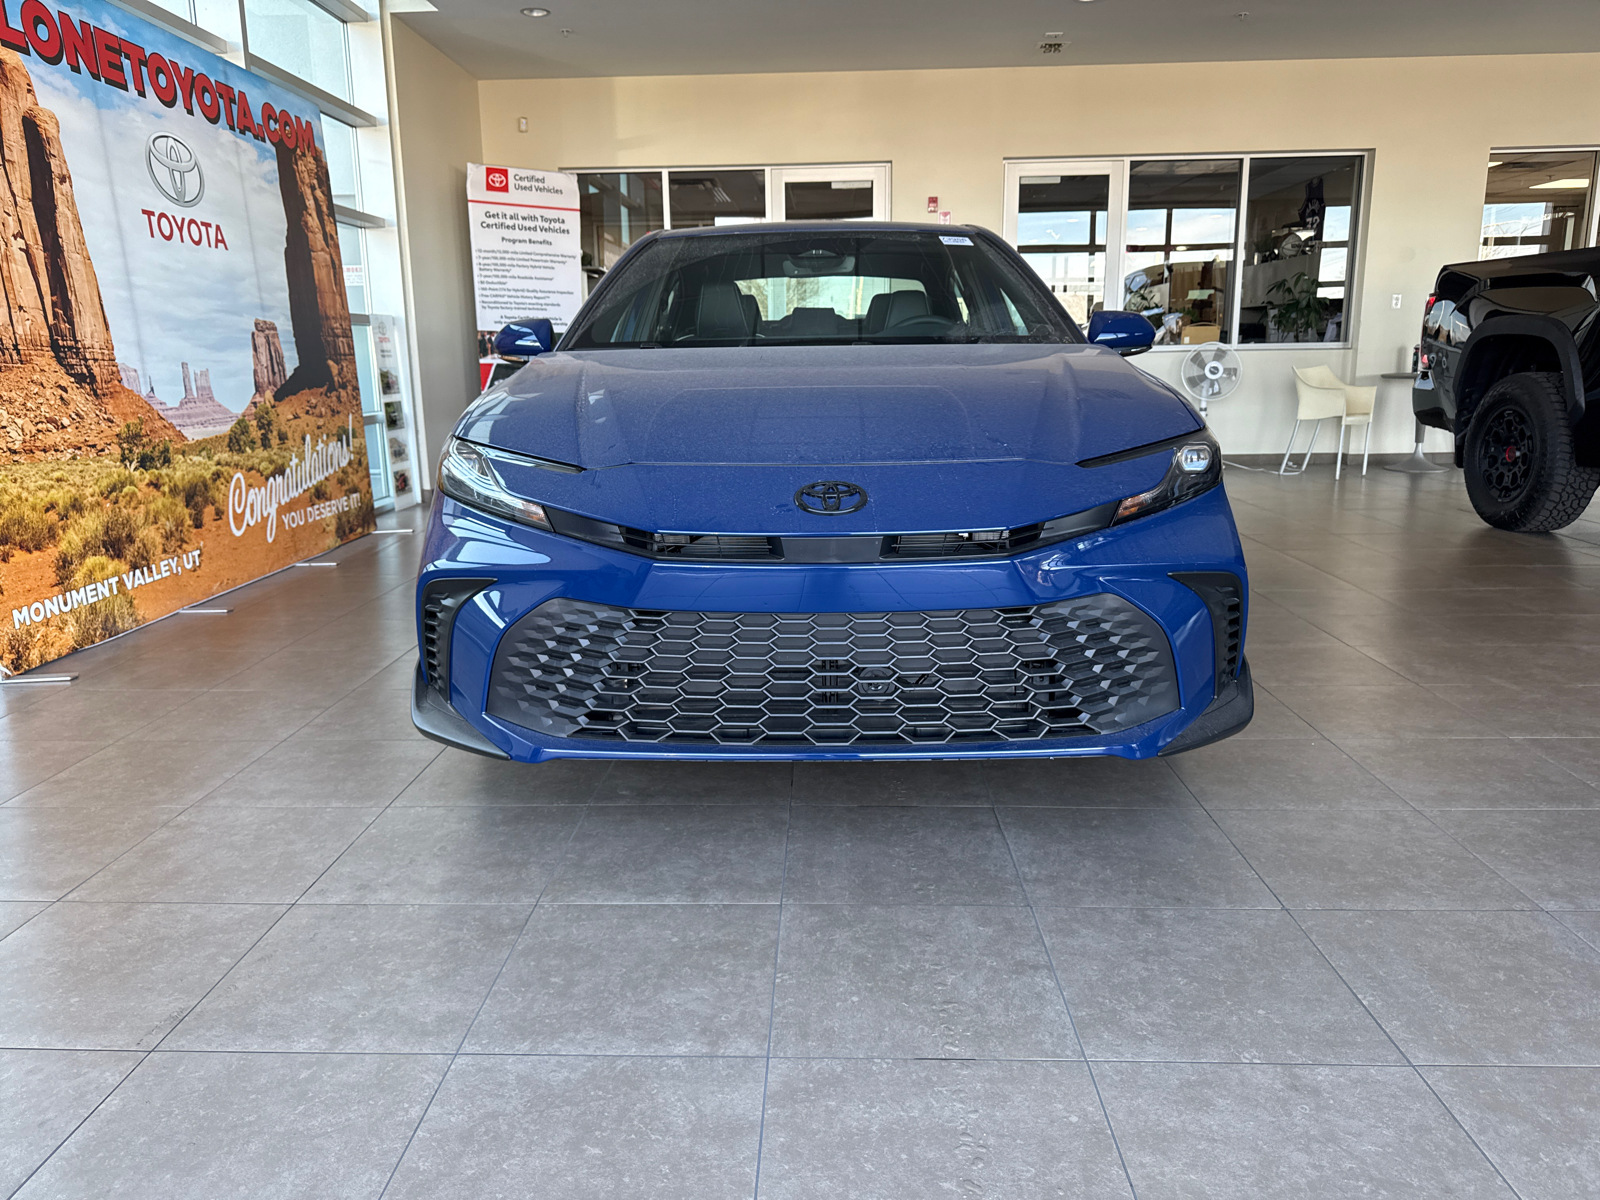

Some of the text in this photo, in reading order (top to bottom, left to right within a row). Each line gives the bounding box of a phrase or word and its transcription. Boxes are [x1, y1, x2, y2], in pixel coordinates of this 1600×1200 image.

[513, 174, 546, 184] Certified
[514, 183, 564, 195] Used Vehicles
[484, 211, 566, 225] Get it all with Toyota
[141, 208, 229, 251] TOYOTA
[480, 221, 570, 235] Certified Used Vehicles
[501, 236, 553, 246] Program Benefits
[228, 413, 354, 543] Congratulations!
[281, 493, 362, 531] YOU DESERVE IT!
[12, 550, 201, 630] MONUMENT VALLEY, UT
